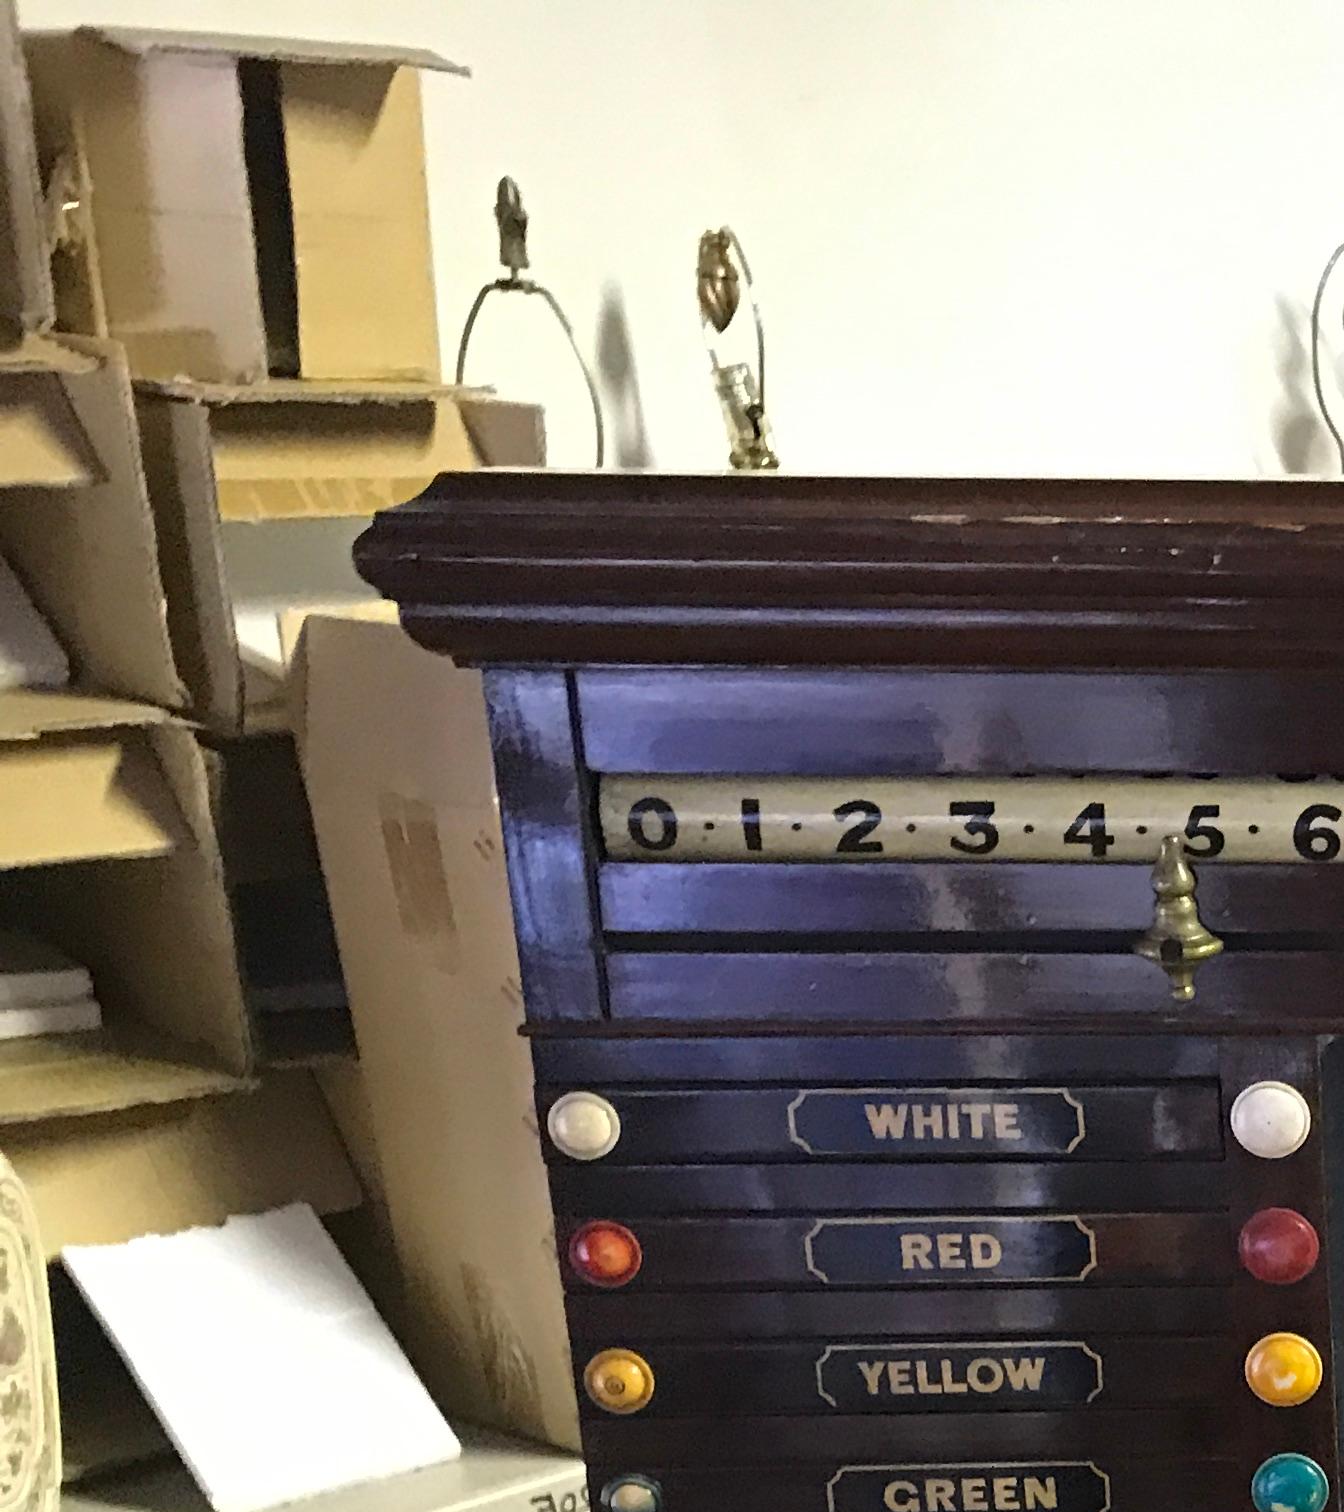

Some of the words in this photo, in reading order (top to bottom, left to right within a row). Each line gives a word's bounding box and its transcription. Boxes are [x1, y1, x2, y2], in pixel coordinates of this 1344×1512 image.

[627, 797, 679, 851] 0
[741, 799, 762, 852] 1
[832, 800, 884, 854] 2
[949, 801, 1000, 854] 3
[1063, 803, 1115, 856] 4
[1183, 805, 1225, 857] 5
[1293, 804, 1341, 860] 6
[864, 1103, 1023, 1139] WHITE
[900, 1233, 1002, 1270] RED
[858, 1357, 1045, 1395] YELLOW
